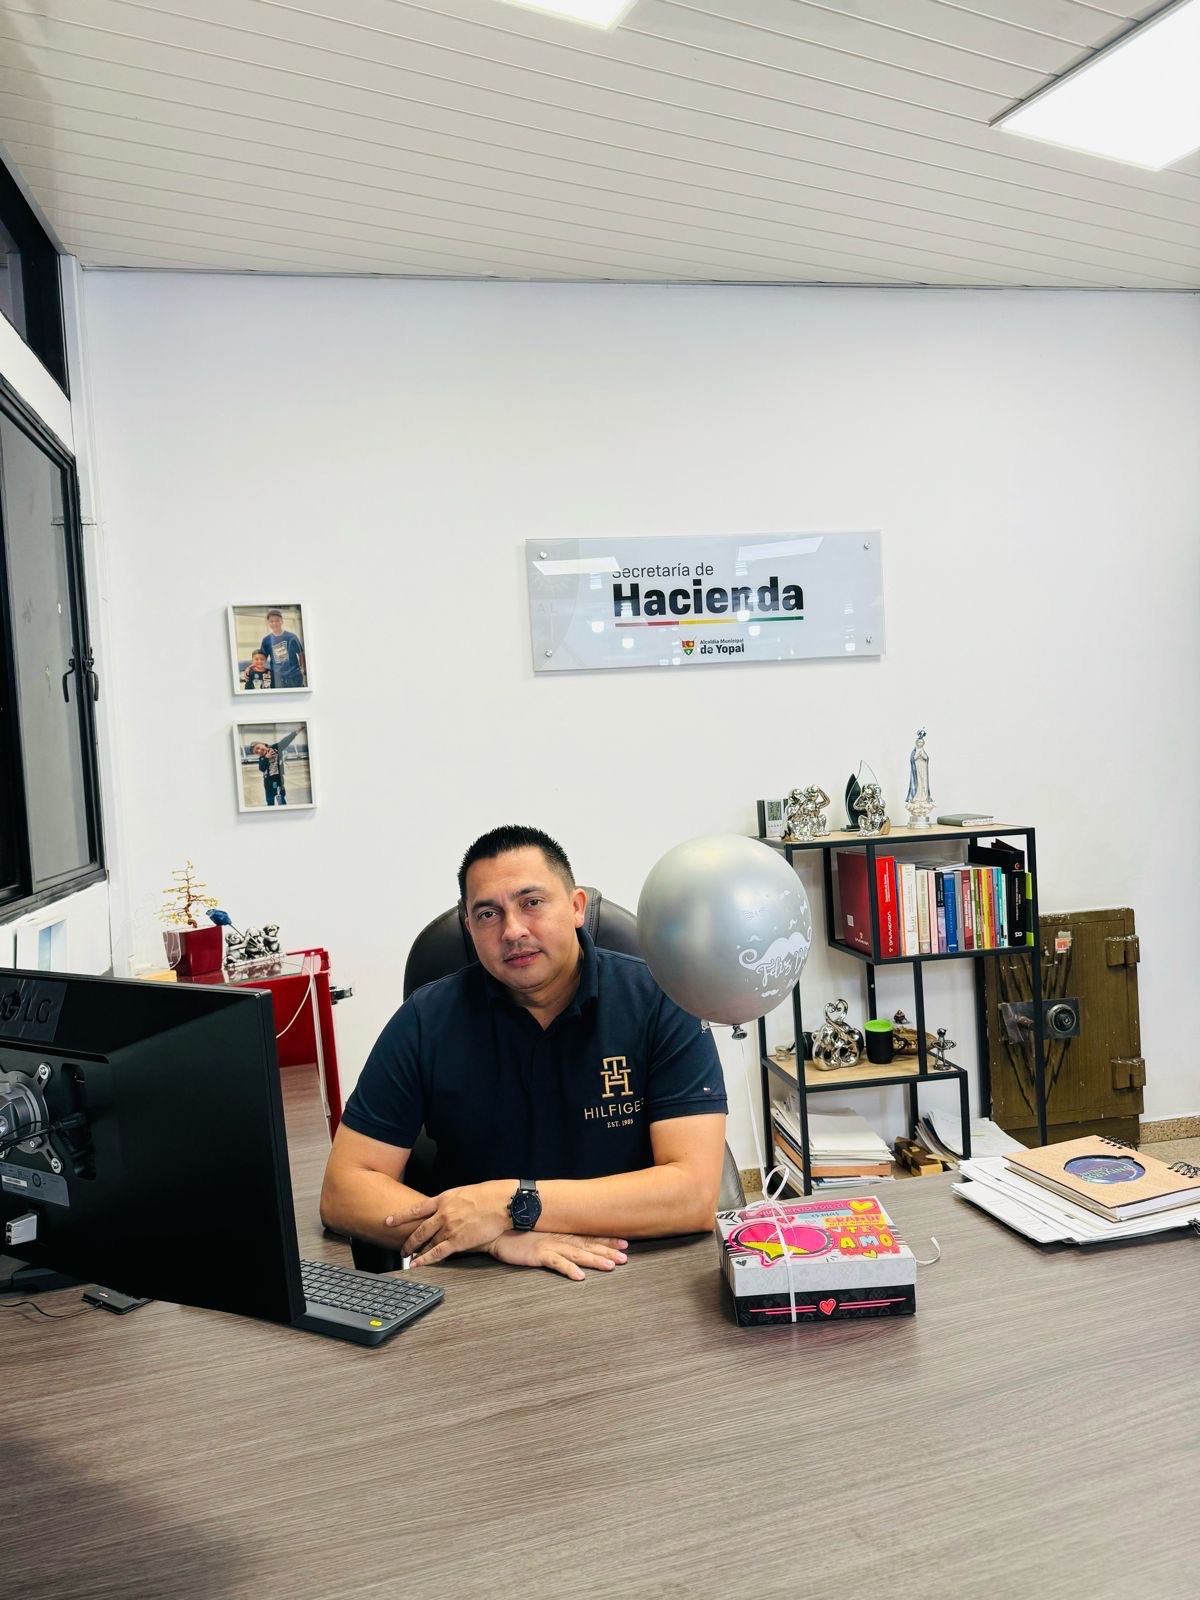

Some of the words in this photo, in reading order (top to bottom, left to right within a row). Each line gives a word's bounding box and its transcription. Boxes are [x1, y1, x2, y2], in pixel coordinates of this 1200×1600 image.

[695, 562, 714, 576] de
[613, 576, 804, 617] Hacienda
[700, 645, 713, 654] de
[716, 643, 745, 656] Yopal
[24, 997, 54, 1024] LG
[584, 1097, 644, 1120] HILFIGE
[607, 1120, 621, 1128] EST.
[840, 1233, 893, 1249] AMO
